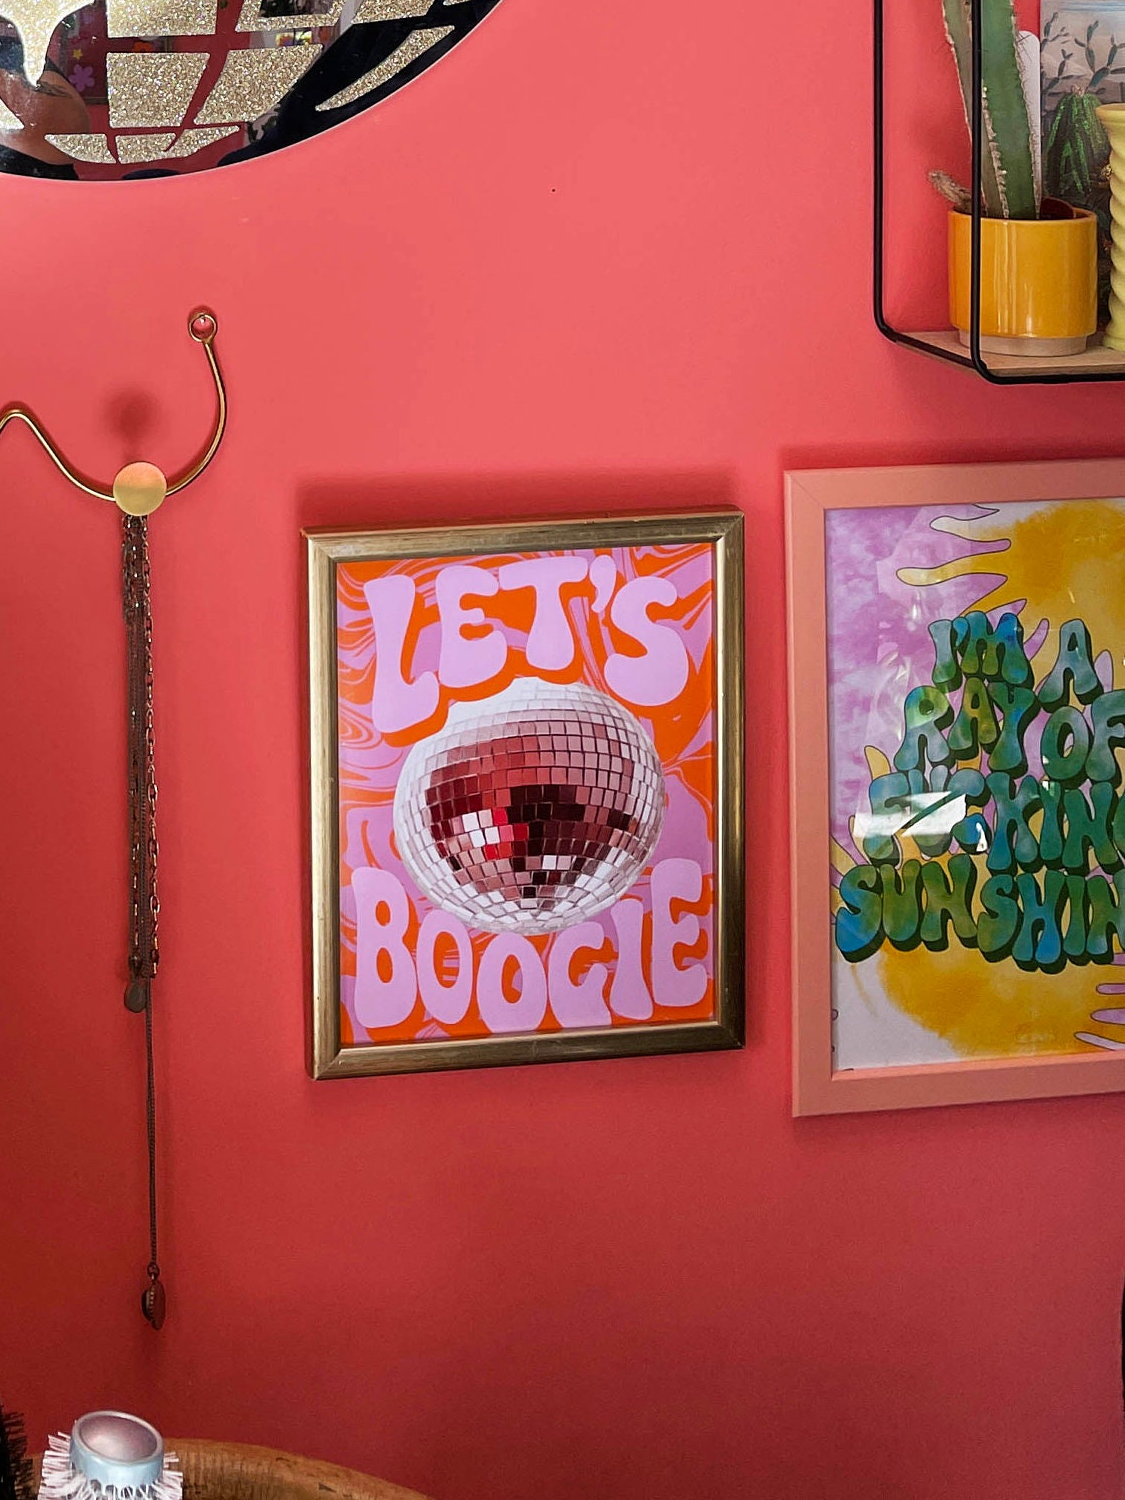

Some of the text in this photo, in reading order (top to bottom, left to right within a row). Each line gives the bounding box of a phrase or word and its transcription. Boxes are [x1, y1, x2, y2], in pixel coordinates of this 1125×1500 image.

[363, 555, 689, 734] LET'S
[928, 610, 1103, 713] I'M A
[893, 677, 1125, 788] RAY OF
[863, 764, 1125, 876] FUCKIN
[351, 858, 708, 1034] BOOGIE
[835, 852, 1125, 974] SUNSHIN
